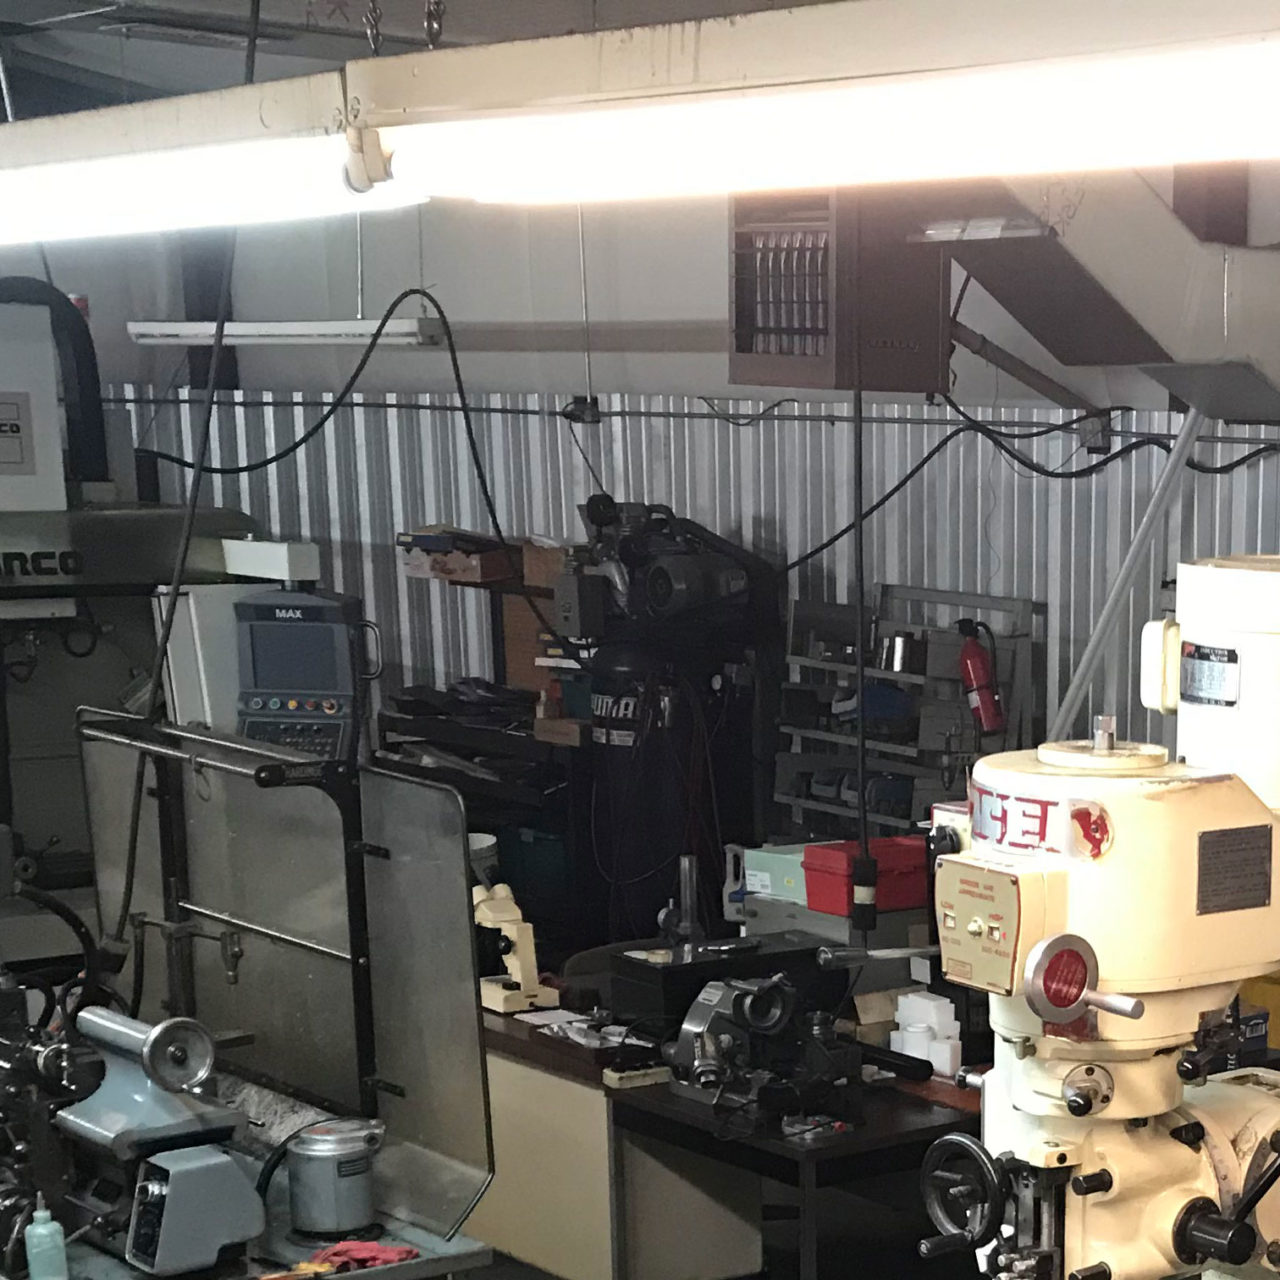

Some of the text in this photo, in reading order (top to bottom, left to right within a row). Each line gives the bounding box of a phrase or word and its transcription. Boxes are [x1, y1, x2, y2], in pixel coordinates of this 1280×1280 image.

[0, 551, 83, 576] RCO
[275, 608, 303, 619] MAX
[591, 693, 638, 718] UMA
